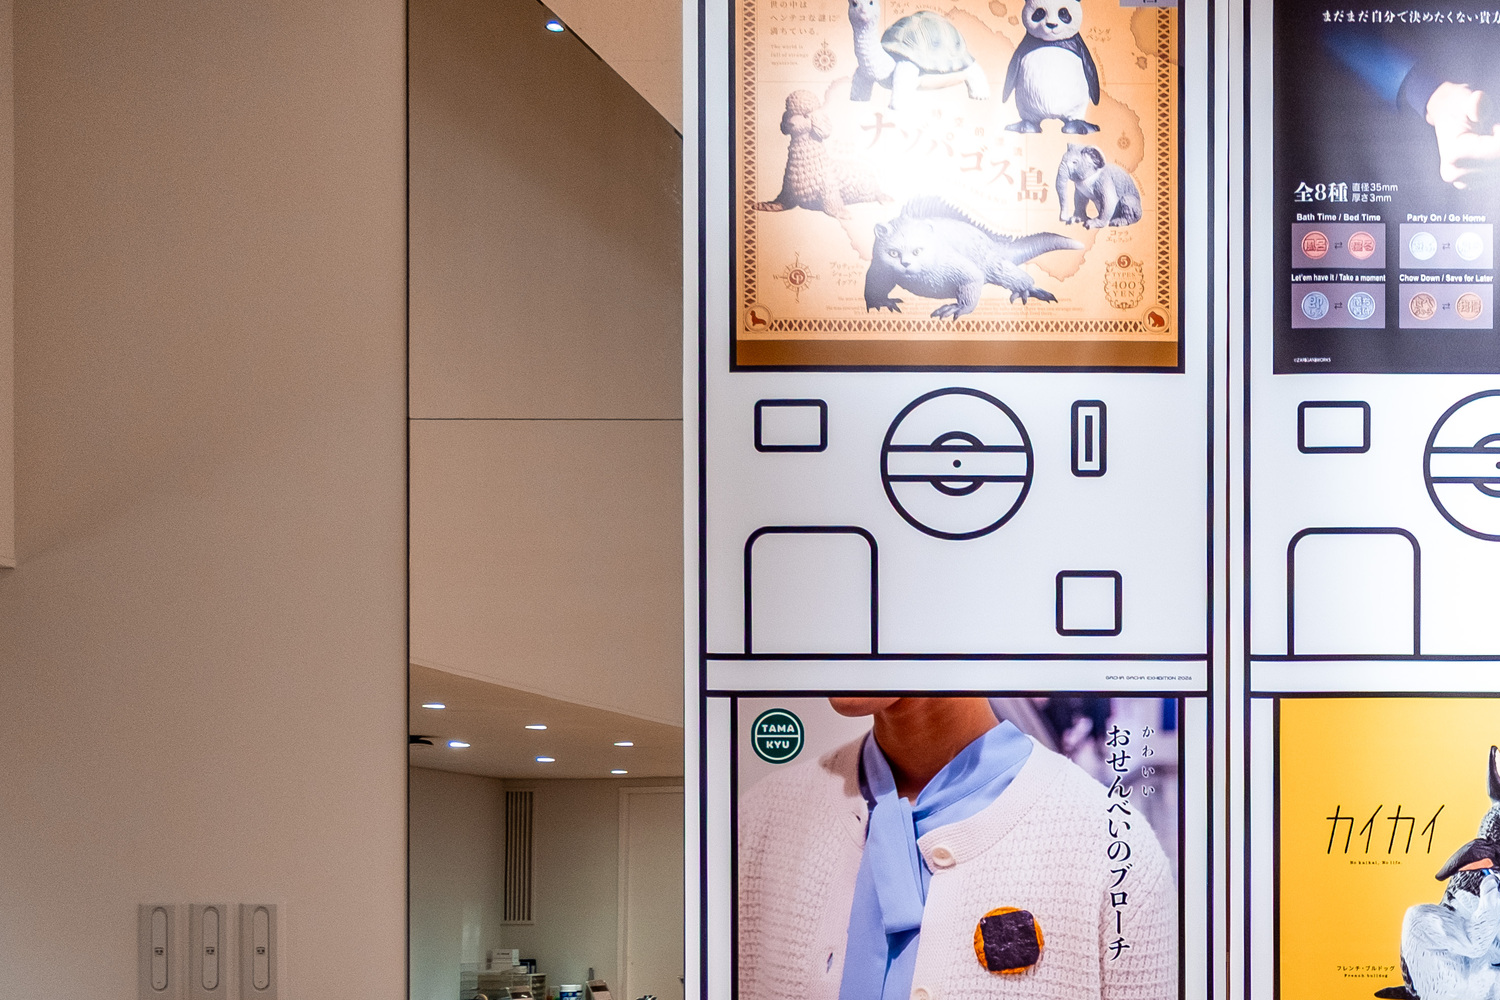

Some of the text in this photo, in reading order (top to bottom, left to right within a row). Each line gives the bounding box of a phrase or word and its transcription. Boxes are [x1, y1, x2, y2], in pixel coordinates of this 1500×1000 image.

[860, 112, 1049, 204] ナゾパゴス島
[1294, 181, 1349, 203] 全8種
[1296, 213, 1316, 222] Bath
[1317, 213, 1337, 222] Time
[1343, 213, 1360, 222] Bed
[1361, 213, 1381, 222] Time
[1407, 214, 1428, 224] Party
[1430, 214, 1442, 222] On
[1449, 214, 1461, 222] Go
[1462, 214, 1486, 223] Home
[1120, 256, 1128, 267] 5
[1313, 274, 1329, 282] have
[1339, 274, 1354, 282] Take
[1360, 274, 1386, 283] moment
[1399, 274, 1418, 282] Chow
[1420, 274, 1440, 282] Down
[1446, 274, 1462, 282] Save
[1463, 274, 1474, 282] for
[1475, 274, 1494, 283] Later
[1112, 280, 1136, 290] 400
[1112, 290, 1135, 298] YEN
[761, 724, 795, 733] TAMA
[766, 740, 790, 749] KYU
[1141, 725, 1156, 797] かわいい
[1325, 804, 1445, 854] カイカイ
[1106, 724, 1133, 962] おせんべいのブローチ
